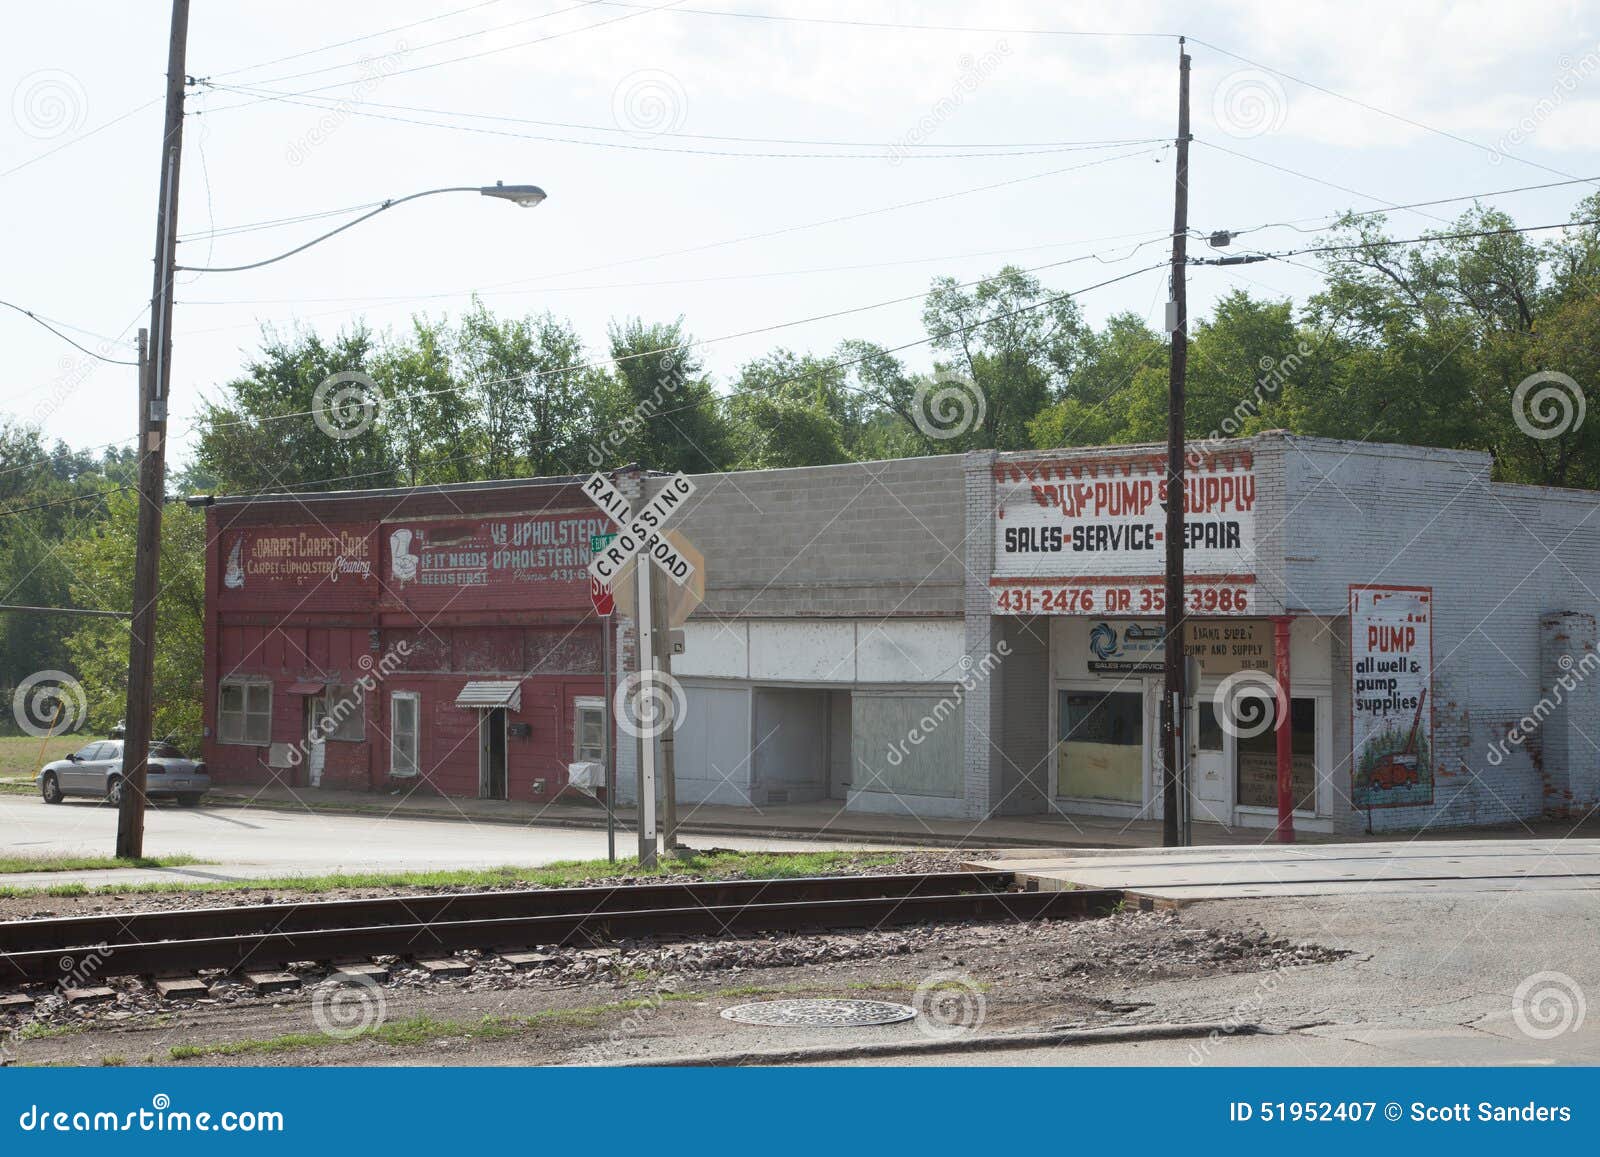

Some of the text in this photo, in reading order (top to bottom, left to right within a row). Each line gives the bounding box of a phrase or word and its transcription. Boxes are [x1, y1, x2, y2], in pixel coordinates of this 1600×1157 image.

[1095, 480, 1153, 516] PUMP
[514, 519, 610, 547] UPHOLSTERY
[588, 478, 687, 577] RAIL ROAD
[597, 478, 689, 577] CROSSING
[1005, 521, 1240, 552] SALES SERVICE EPAIR
[300, 533, 337, 557] CARPET
[449, 552, 487, 568] NEEDS
[493, 546, 594, 569] UPHOLSTERIN
[247, 560, 279, 574] CARPET
[998, 587, 1248, 612] 431-2476 OR 35-3986
[1368, 625, 1415, 652] PUMP
[1356, 657, 1421, 673] all well &
[1356, 678, 1397, 696] pump
[1357, 692, 1418, 717] supplies
